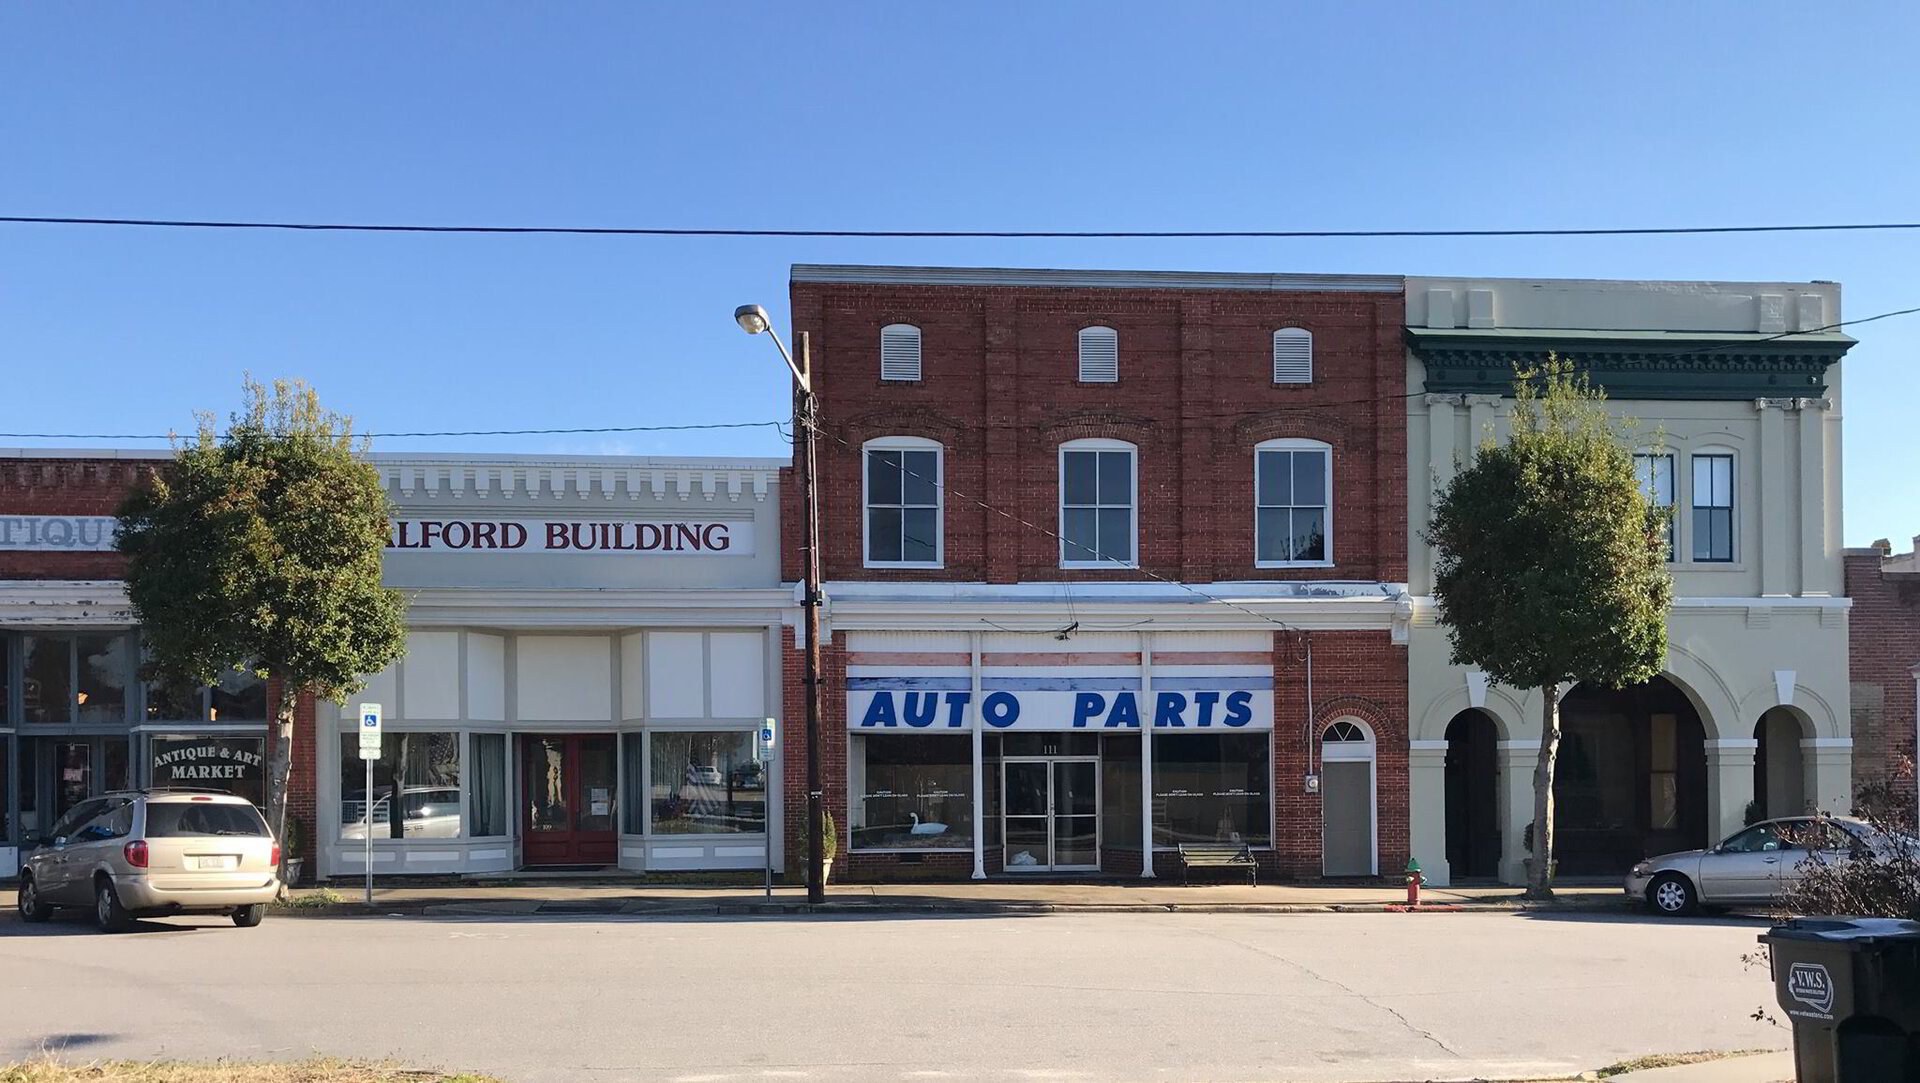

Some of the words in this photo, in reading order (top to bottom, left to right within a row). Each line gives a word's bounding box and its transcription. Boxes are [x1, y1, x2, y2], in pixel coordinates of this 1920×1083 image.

[385, 521, 528, 549] LFORD
[545, 522, 730, 551] BUILDING
[861, 691, 1020, 728] AUTO
[1072, 691, 1253, 728] PARTS
[154, 746, 216, 768] ANTIQUE
[219, 747, 230, 759] &
[233, 750, 262, 767] ART
[1043, 744, 1057, 755] 111
[171, 764, 246, 779] MARKET
[1795, 970, 1825, 988] V.W.S.
